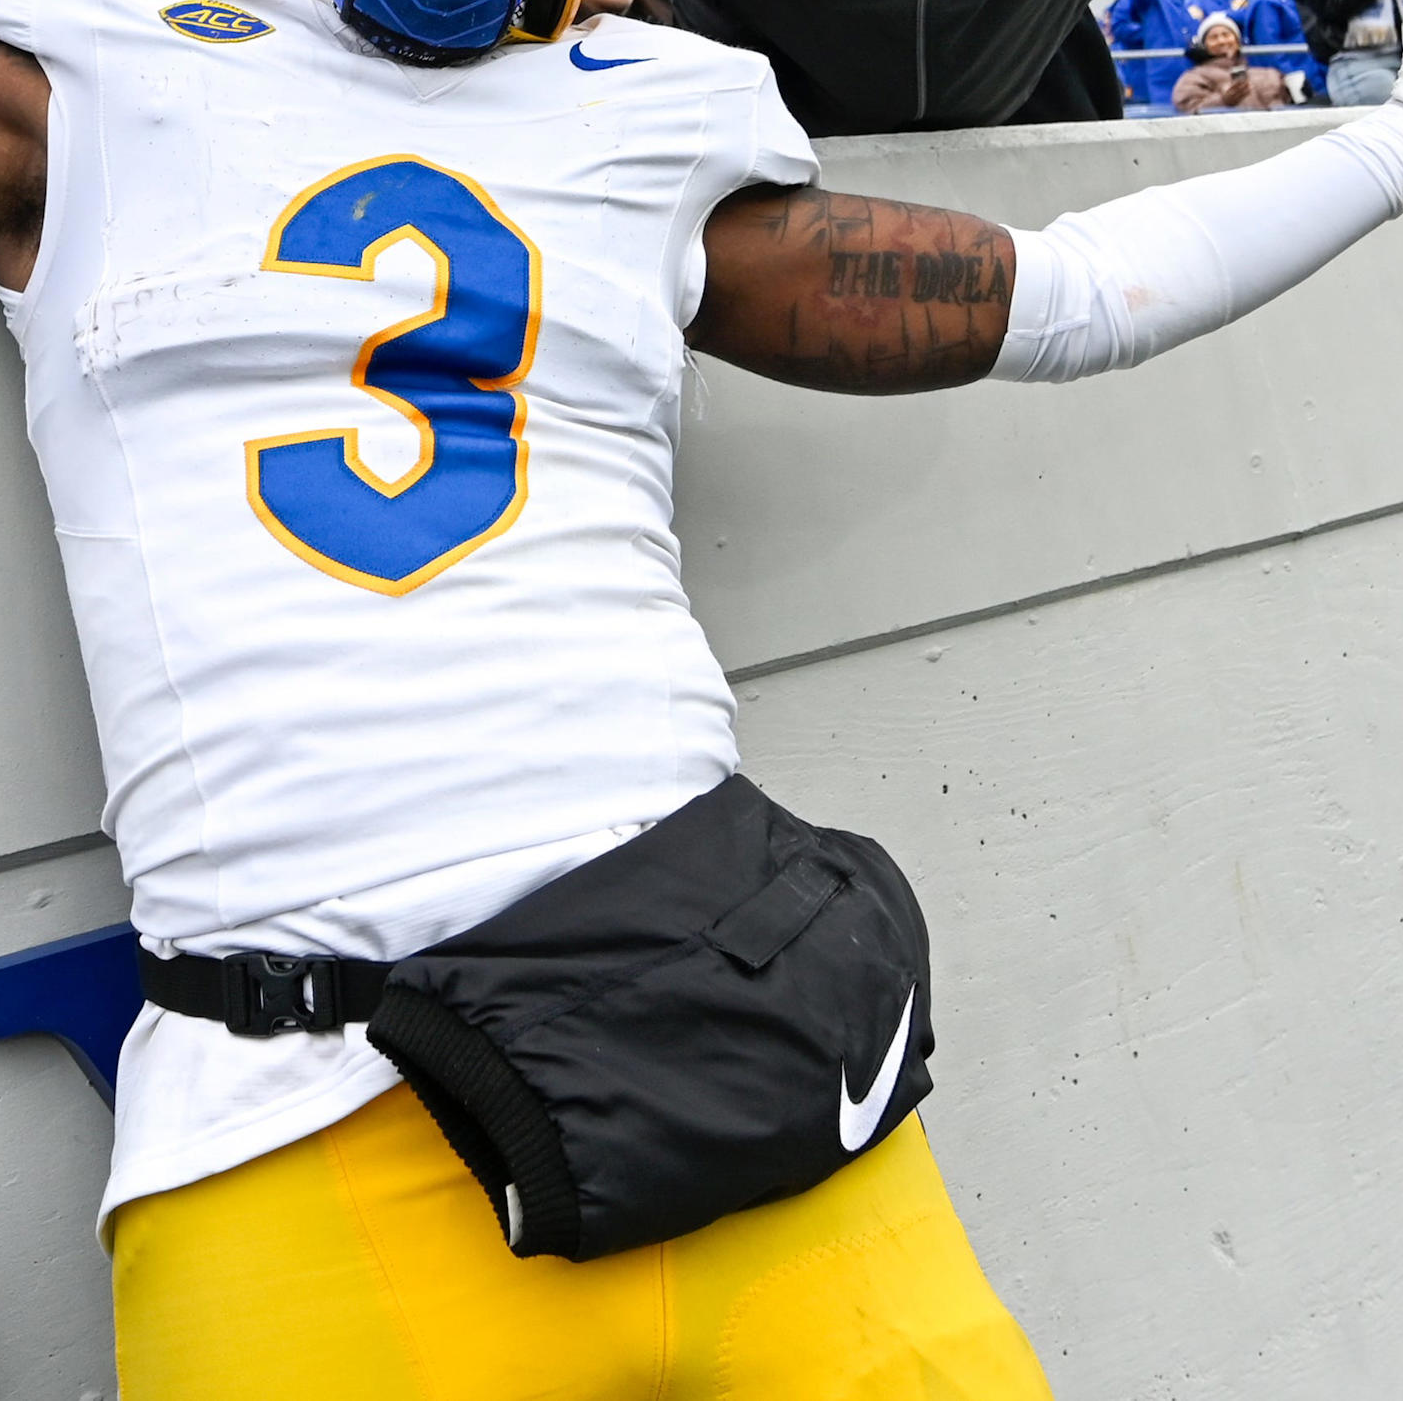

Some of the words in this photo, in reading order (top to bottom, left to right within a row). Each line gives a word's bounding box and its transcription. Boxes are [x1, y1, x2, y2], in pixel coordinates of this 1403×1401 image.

[175, 9, 260, 31] ACC
[830, 251, 902, 298] THE
[244, 153, 542, 597] 3
